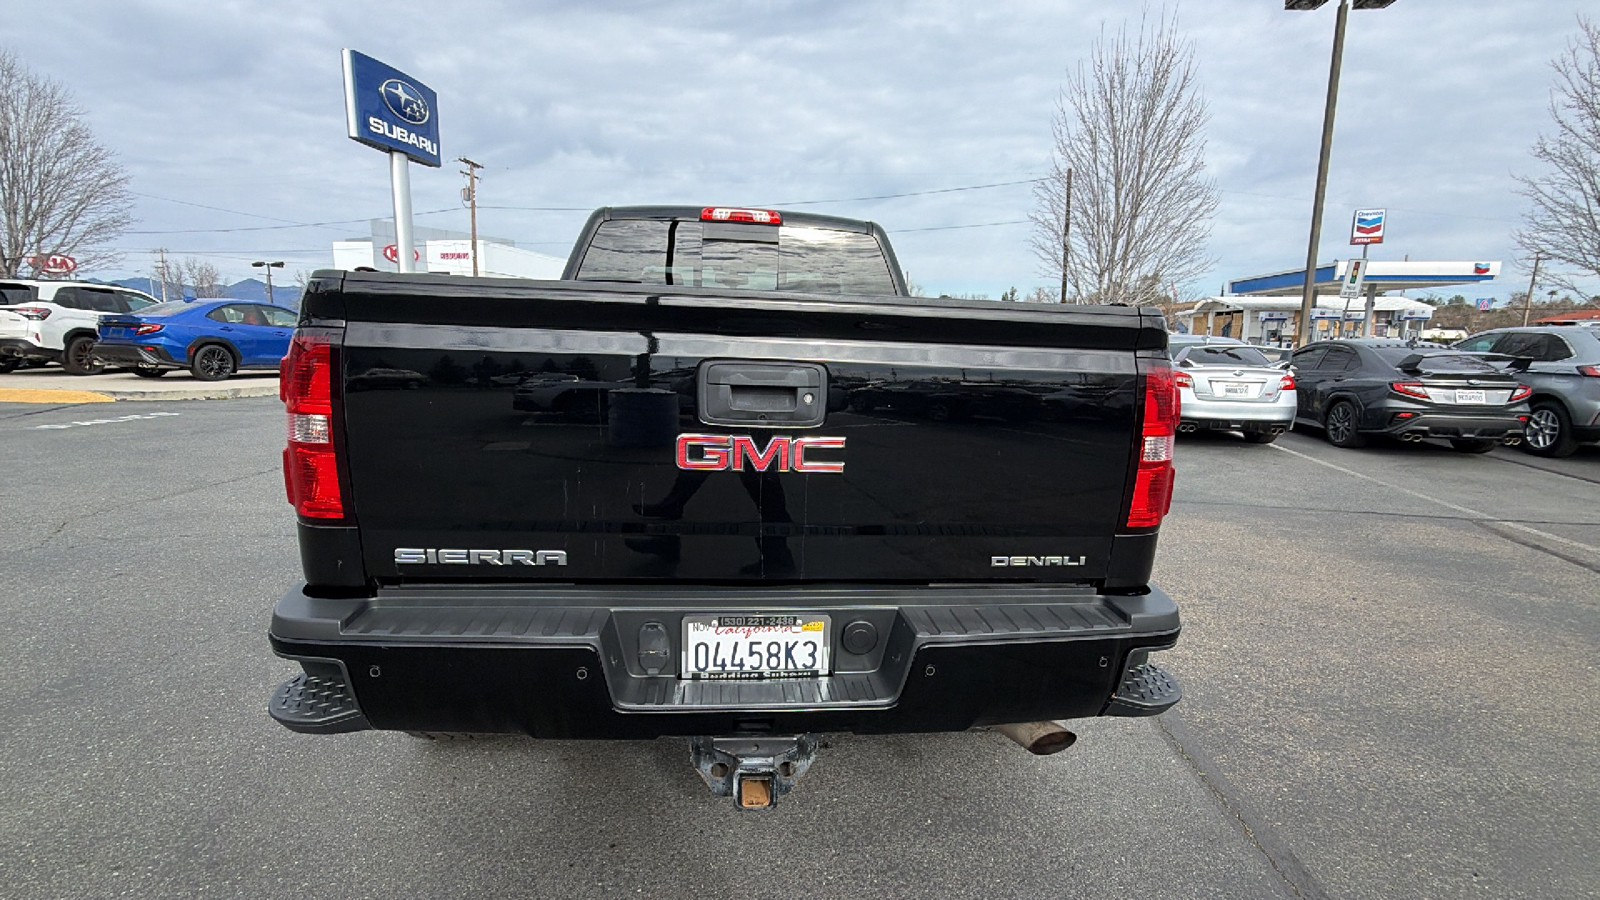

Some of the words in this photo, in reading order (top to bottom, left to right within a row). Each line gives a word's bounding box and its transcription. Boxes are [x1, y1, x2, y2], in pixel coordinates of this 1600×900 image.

[369, 116, 437, 156] SUBARU
[676, 433, 847, 473] GMC
[394, 548, 568, 566] SIERRA
[990, 556, 1087, 567] DENALI
[720, 617, 746, 626] (530)
[694, 640, 818, 672] 04458K3
